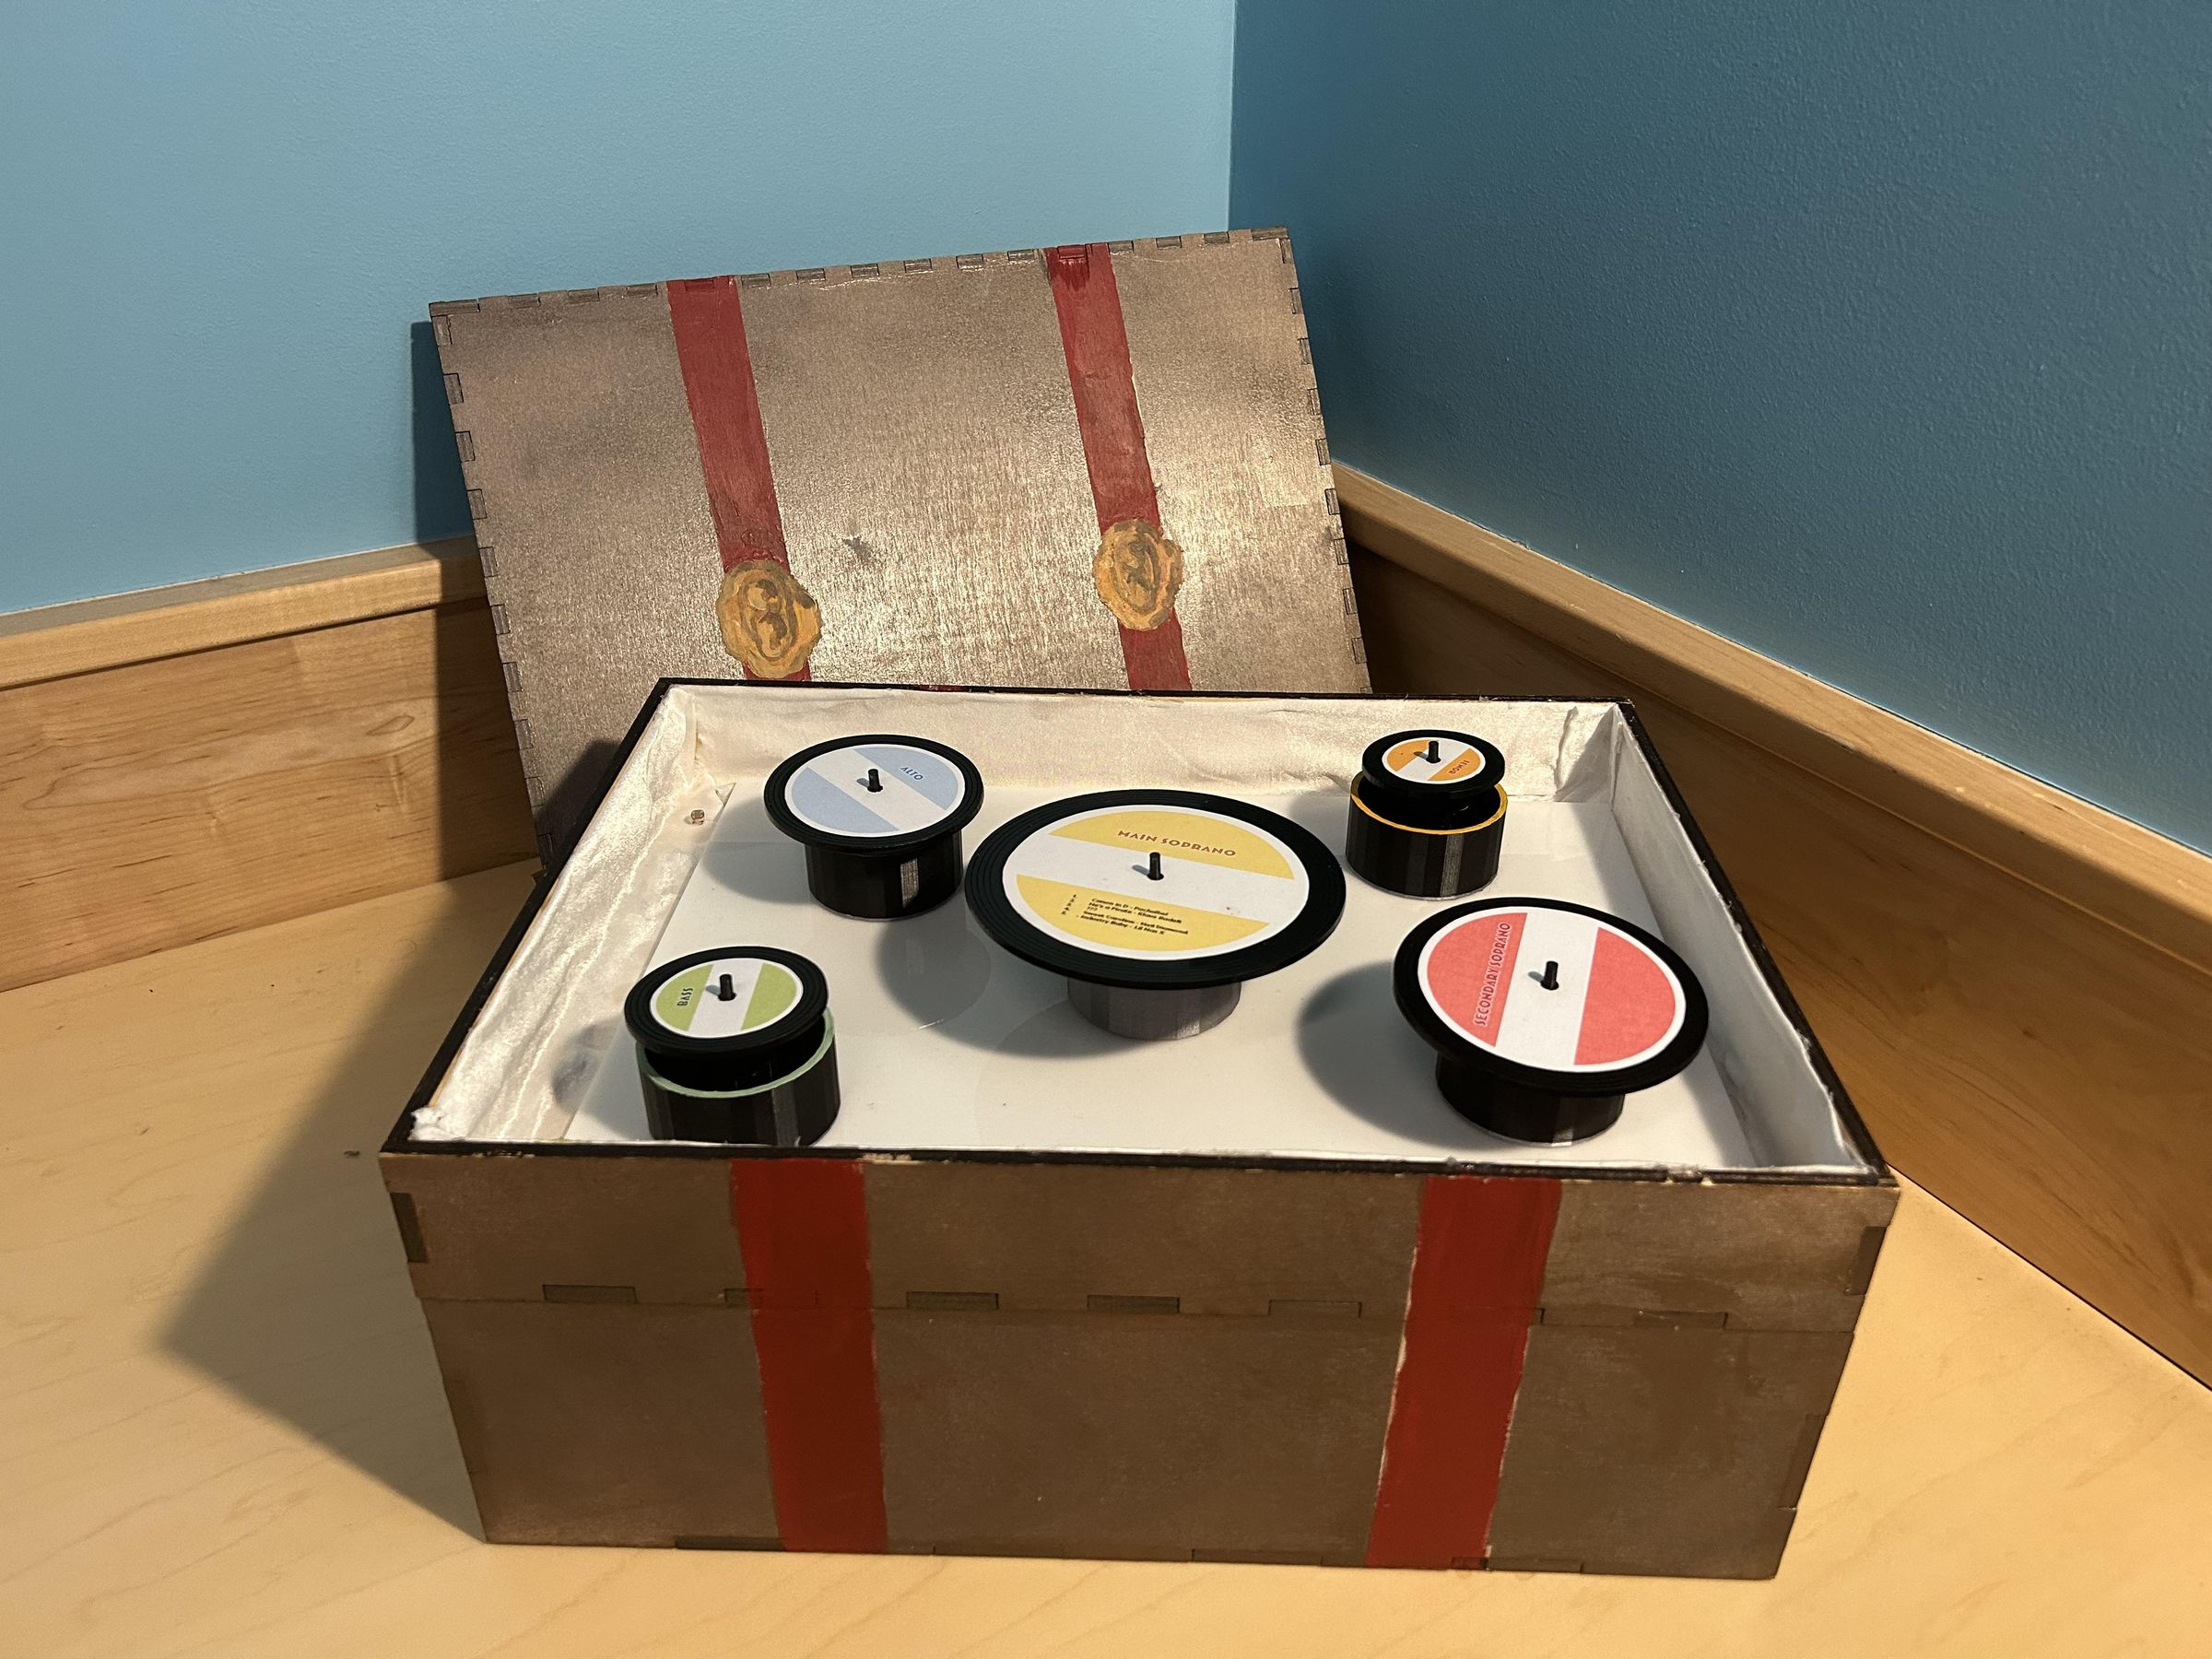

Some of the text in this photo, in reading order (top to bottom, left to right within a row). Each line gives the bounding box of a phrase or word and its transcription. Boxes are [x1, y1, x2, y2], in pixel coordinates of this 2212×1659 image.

[900, 766, 924, 781] ALTO
[1117, 830, 1237, 857] MAIN SOPRANO
[1474, 922, 1511, 1026] SECONDARY SOPRANO
[677, 987, 694, 1007] BASS
